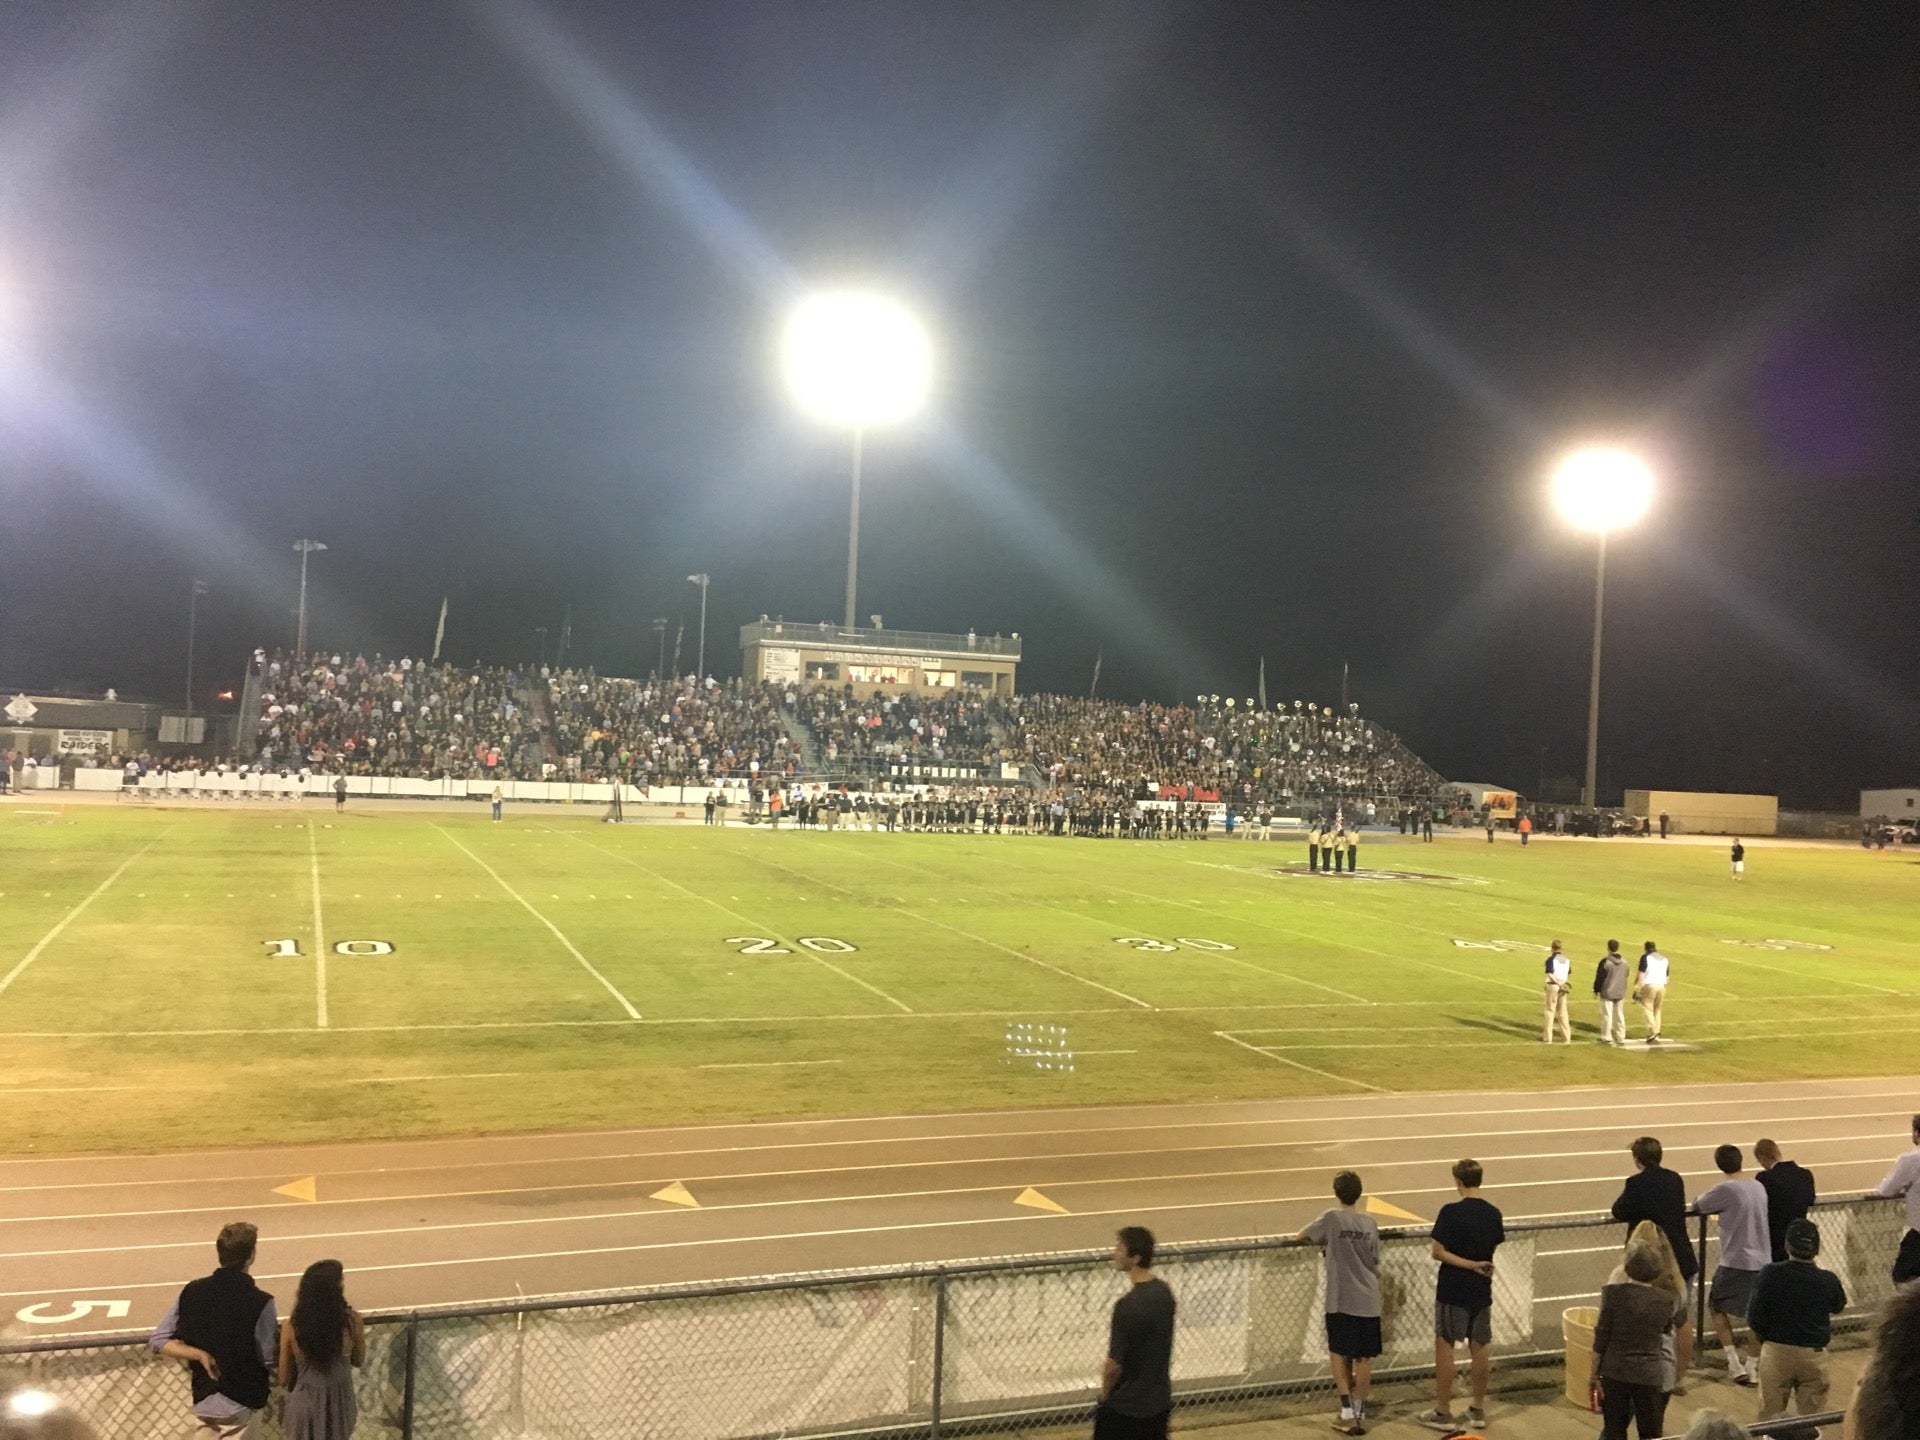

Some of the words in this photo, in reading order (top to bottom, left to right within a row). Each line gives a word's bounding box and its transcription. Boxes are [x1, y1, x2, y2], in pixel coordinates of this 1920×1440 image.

[263, 938, 396, 957] 10
[725, 937, 858, 954] 20
[1112, 937, 1239, 951] 30
[15, 1299, 131, 1324] 5
